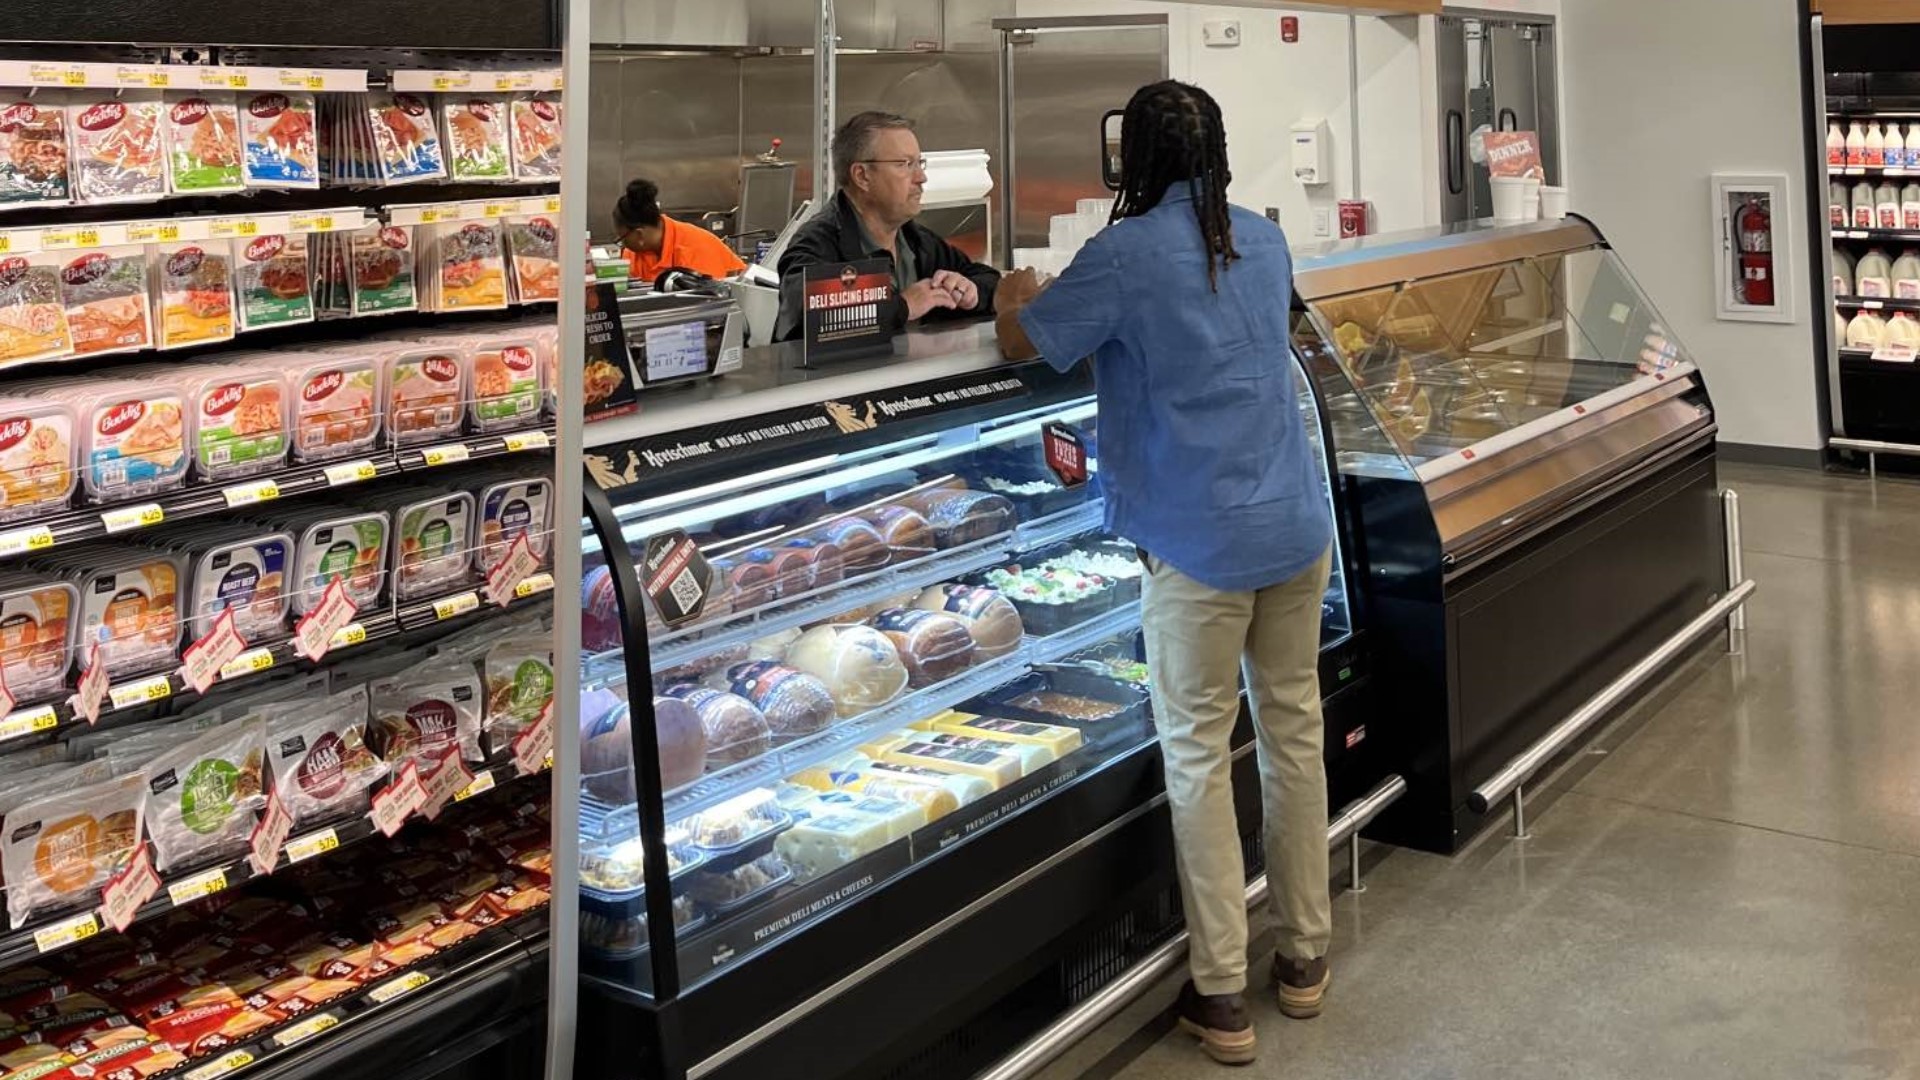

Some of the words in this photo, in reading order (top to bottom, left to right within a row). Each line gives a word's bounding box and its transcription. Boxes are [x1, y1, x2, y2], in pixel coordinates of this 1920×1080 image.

[809, 295, 828, 309] DELI
[829, 289, 861, 307] SLICING
[863, 286, 888, 301] GUIDE
[206, 385, 243, 413] Buddig
[877, 396, 933, 416] Kretschmar
[102, 402, 143, 431] Buddig
[642, 441, 712, 468] Kretschmar
[714, 437, 731, 449] NO
[759, 424, 790, 439] FILLERS
[802, 416, 830, 430] GLUTEN
[33, 712, 54, 728] 4.75
[306, 746, 340, 775] HAM
[965, 808, 999, 833] PREMIUM
[1001, 797, 1018, 815] DELI
[1019, 787, 1042, 806] MEATS
[1049, 769, 1078, 788] CHEESES
[205, 877, 225, 894] 5.75
[754, 917, 791, 941] PREMIUM
[791, 907, 810, 924] DELI
[810, 895, 836, 914] MEATS
[841, 875, 873, 898] CHEESES
[74, 922, 96, 936] 5.75
[170, 1003, 231, 1026] BOLOGNA
[86, 1039, 147, 1066] BOLOGNA
